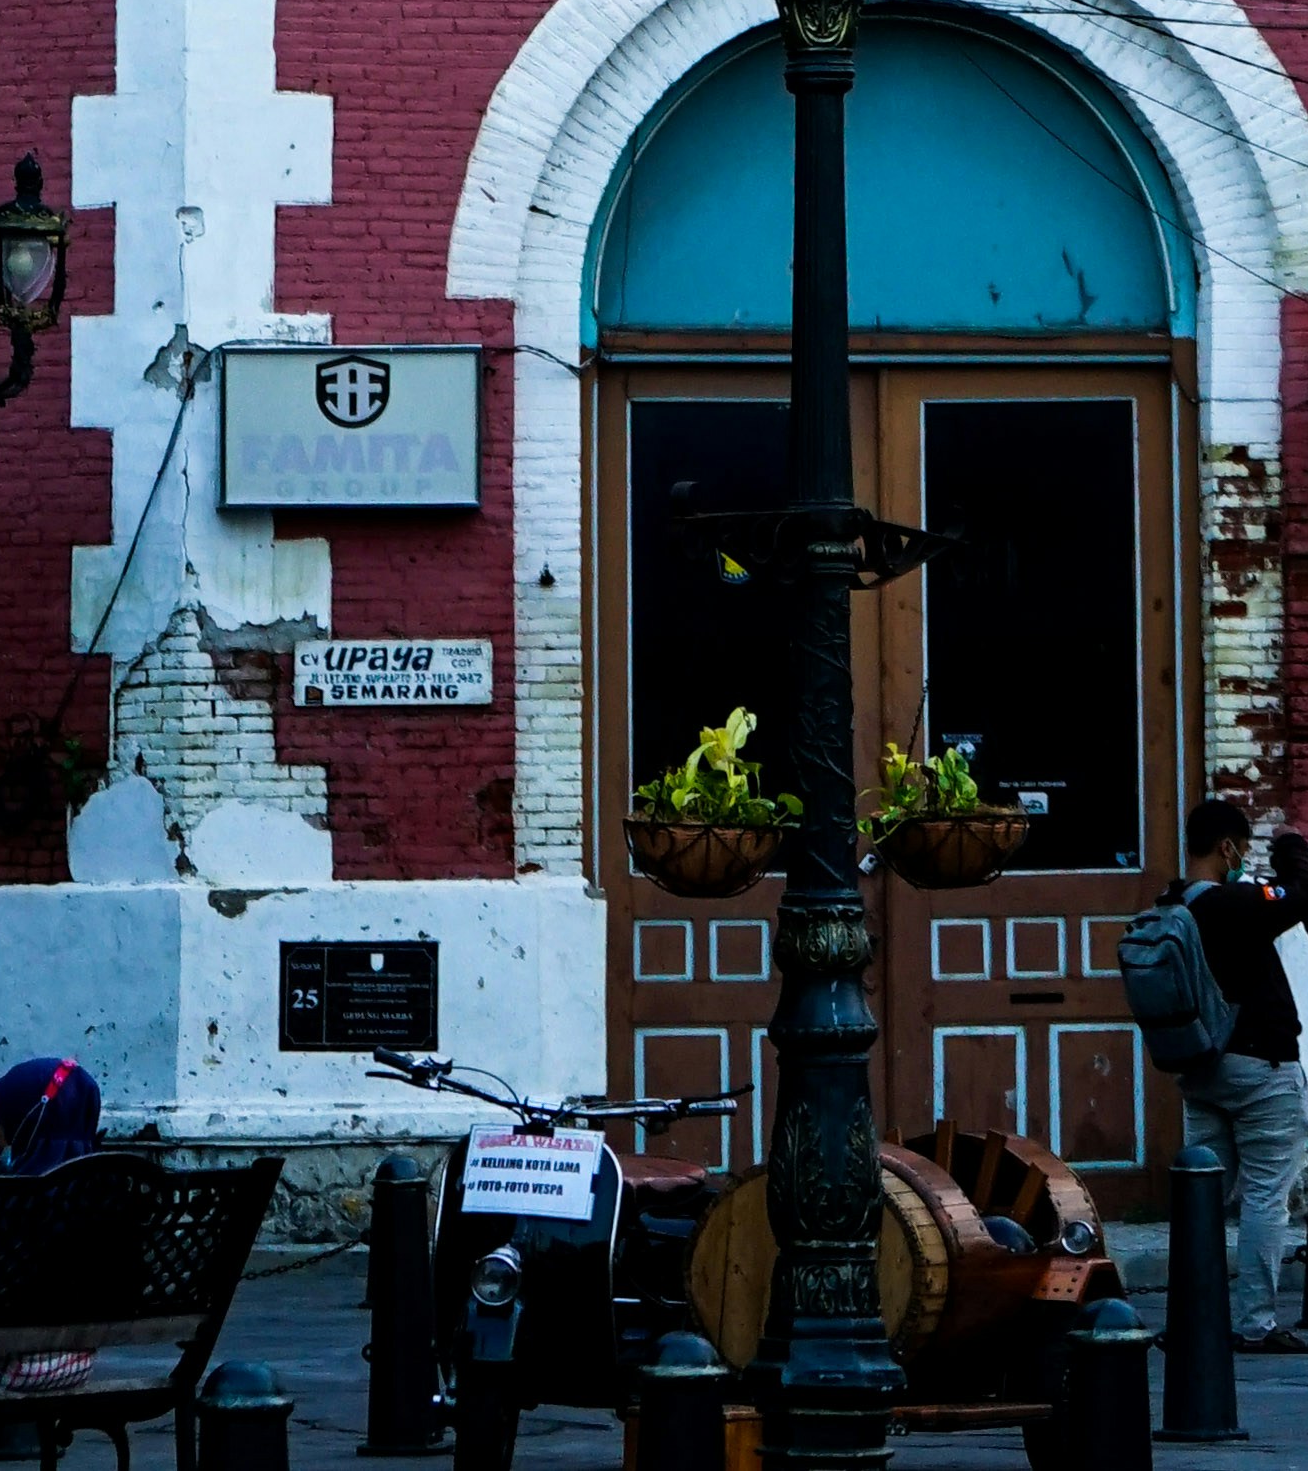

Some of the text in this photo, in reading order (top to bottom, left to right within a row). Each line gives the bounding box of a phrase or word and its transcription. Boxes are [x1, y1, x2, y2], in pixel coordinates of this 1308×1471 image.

[241, 433, 459, 473] FAMITA
[277, 479, 431, 499] GROUP
[300, 653, 319, 667] CV
[332, 685, 460, 700] SEMARANG
[291, 988, 320, 1009] 25
[481, 1157, 524, 1170] KELILING
[525, 1159, 552, 1171] KOTA
[554, 1161, 581, 1174] LAMA
[477, 1180, 530, 1193] FOTO-FOTO
[532, 1183, 564, 1196] VESPA
